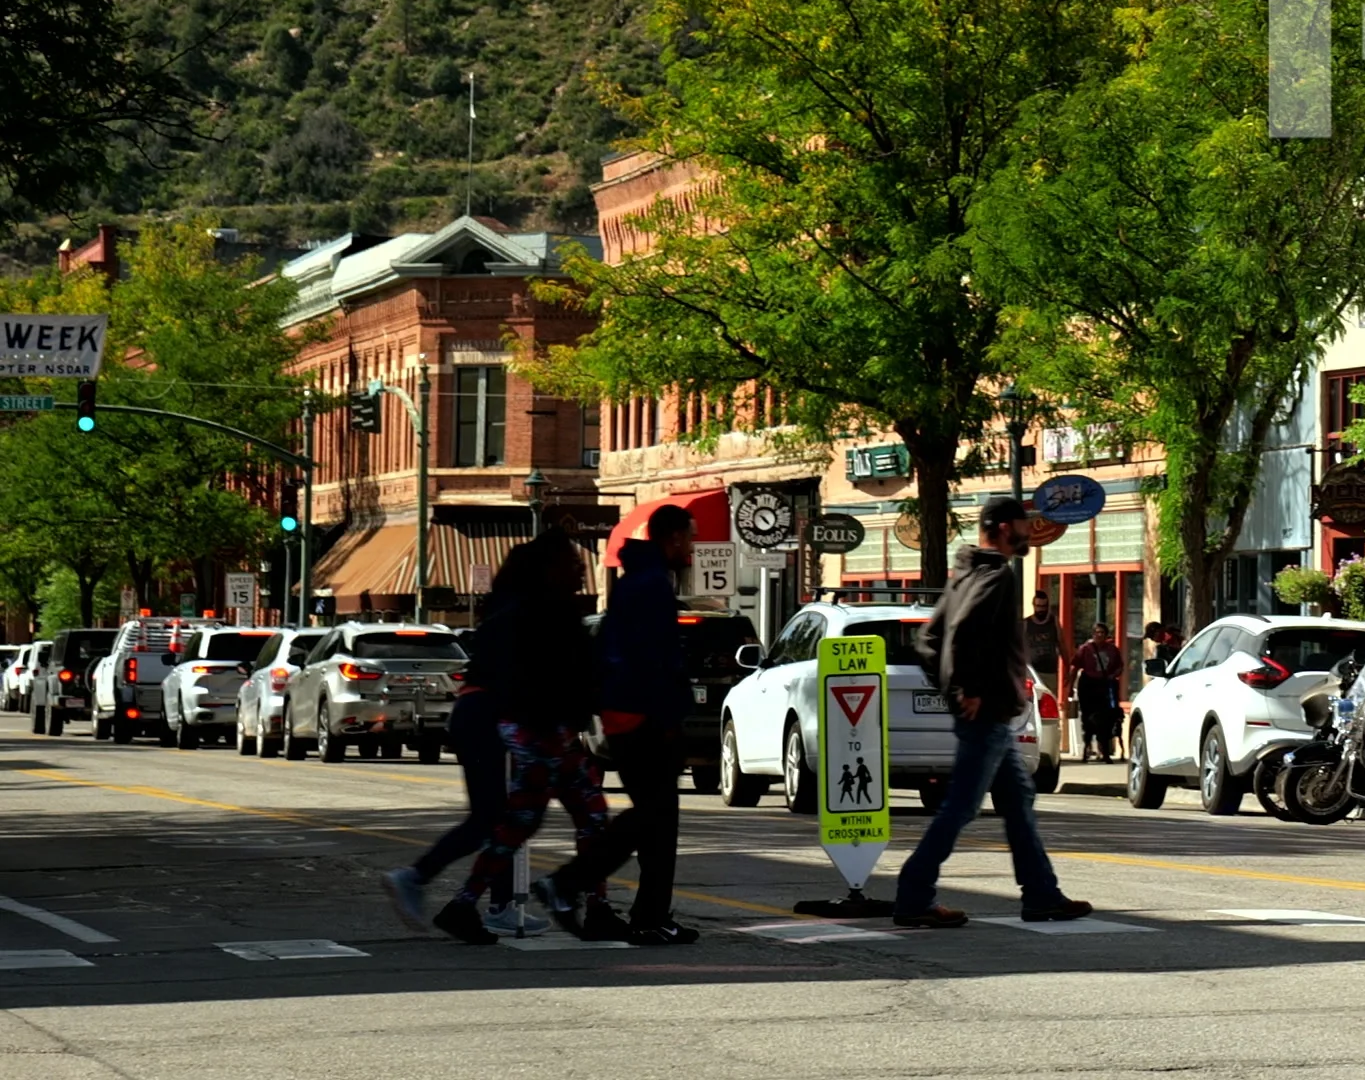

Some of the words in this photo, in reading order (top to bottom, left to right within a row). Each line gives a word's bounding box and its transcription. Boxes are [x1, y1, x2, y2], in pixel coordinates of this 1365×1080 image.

[4, 322, 98, 352] WEEK
[46, 364, 90, 374] NSDAR
[3, 397, 46, 409] STREET
[696, 548, 733, 558] SPEED
[701, 559, 728, 569] LIMIT
[804, 544, 812, 593] ALLERY
[703, 571, 727, 590] 15
[233, 592, 248, 603] 15
[832, 642, 874, 655] STATE
[839, 658, 868, 671] LAW
[848, 742, 862, 751] TO
[841, 816, 872, 825] WITHIN
[828, 827, 884, 839] CROSSWALK
